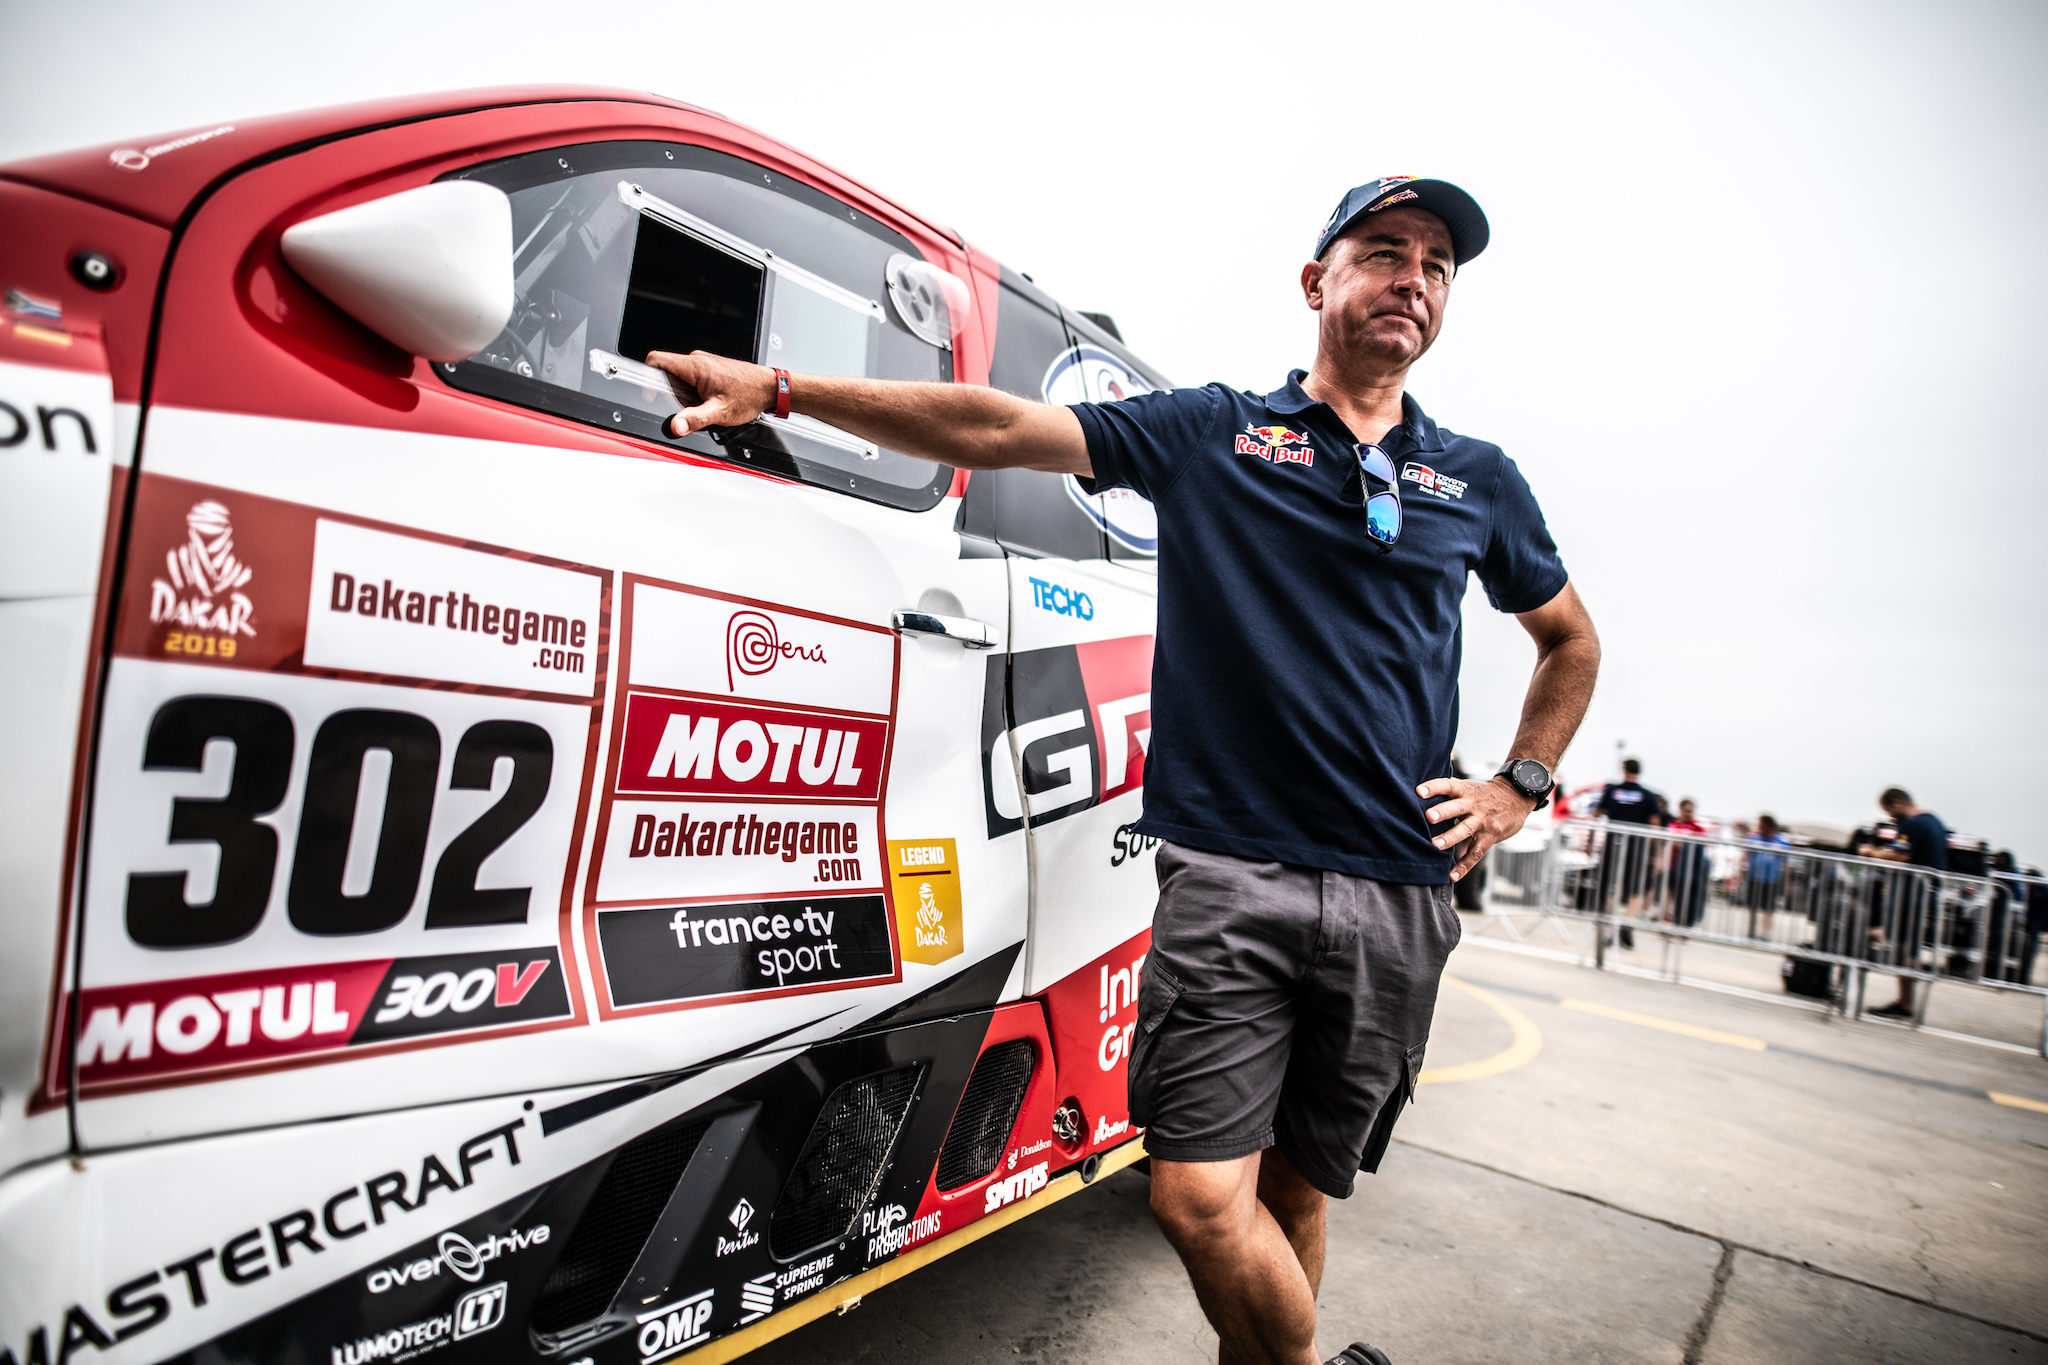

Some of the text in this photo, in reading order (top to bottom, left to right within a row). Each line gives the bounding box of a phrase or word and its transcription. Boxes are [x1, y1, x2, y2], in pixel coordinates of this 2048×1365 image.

[1235, 433, 1315, 467] Red Bull
[1404, 468, 1434, 488] GR
[1435, 473, 1468, 489] TOYOTA
[149, 579, 257, 638] DAKAR
[330, 572, 587, 649] Dakarthegame
[1028, 576, 1094, 621] TECHO
[164, 632, 238, 658] 2019
[532, 648, 584, 673] .com
[726, 610, 828, 693] Perú
[648, 714, 862, 787] MOTUL
[124, 693, 554, 951] 302
[629, 813, 859, 863] Dakarthegame
[813, 858, 862, 882] .com
[900, 846, 946, 866] LEGEND
[914, 925, 948, 947] DAKAR
[758, 939, 841, 986] sport
[77, 959, 551, 1067] MOTUL 300V
[1020, 1138, 1052, 1158] Donaldson
[984, 1160, 1049, 1214] SMITHS
[716, 1230, 760, 1258] Peritus
[867, 1209, 942, 1263] PRODUCTIONS
[775, 1253, 835, 1290] SUPREME
[783, 1273, 824, 1300] SPRING
[331, 1312, 453, 1365] LUMOTECH
[638, 1299, 714, 1357] OMP
